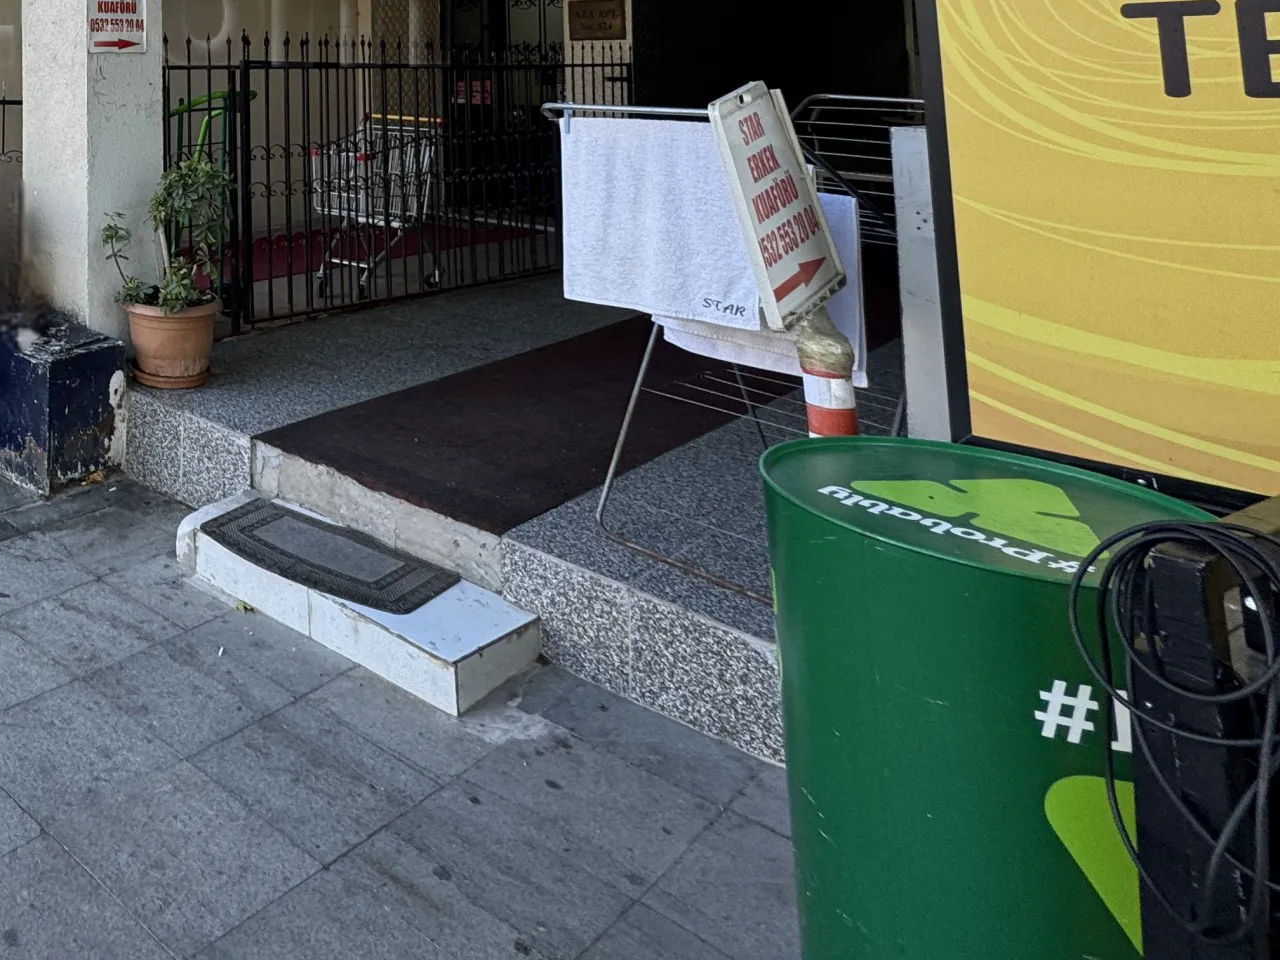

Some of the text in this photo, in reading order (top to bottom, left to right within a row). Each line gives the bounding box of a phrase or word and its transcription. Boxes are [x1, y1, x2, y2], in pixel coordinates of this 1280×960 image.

[90, 18, 109, 32] 0532
[110, 18, 124, 32] 553
[125, 18, 134, 32] 20
[97, 0, 137, 14] KUAFÖRÜ
[738, 111, 766, 147] STAR
[746, 144, 781, 184] ERKEK
[752, 169, 799, 225] KUAFÖRÜ
[777, 218, 798, 256] 553
[792, 211, 810, 244] 20
[803, 203, 821, 237] 04
[702, 297, 747, 319] STAR
